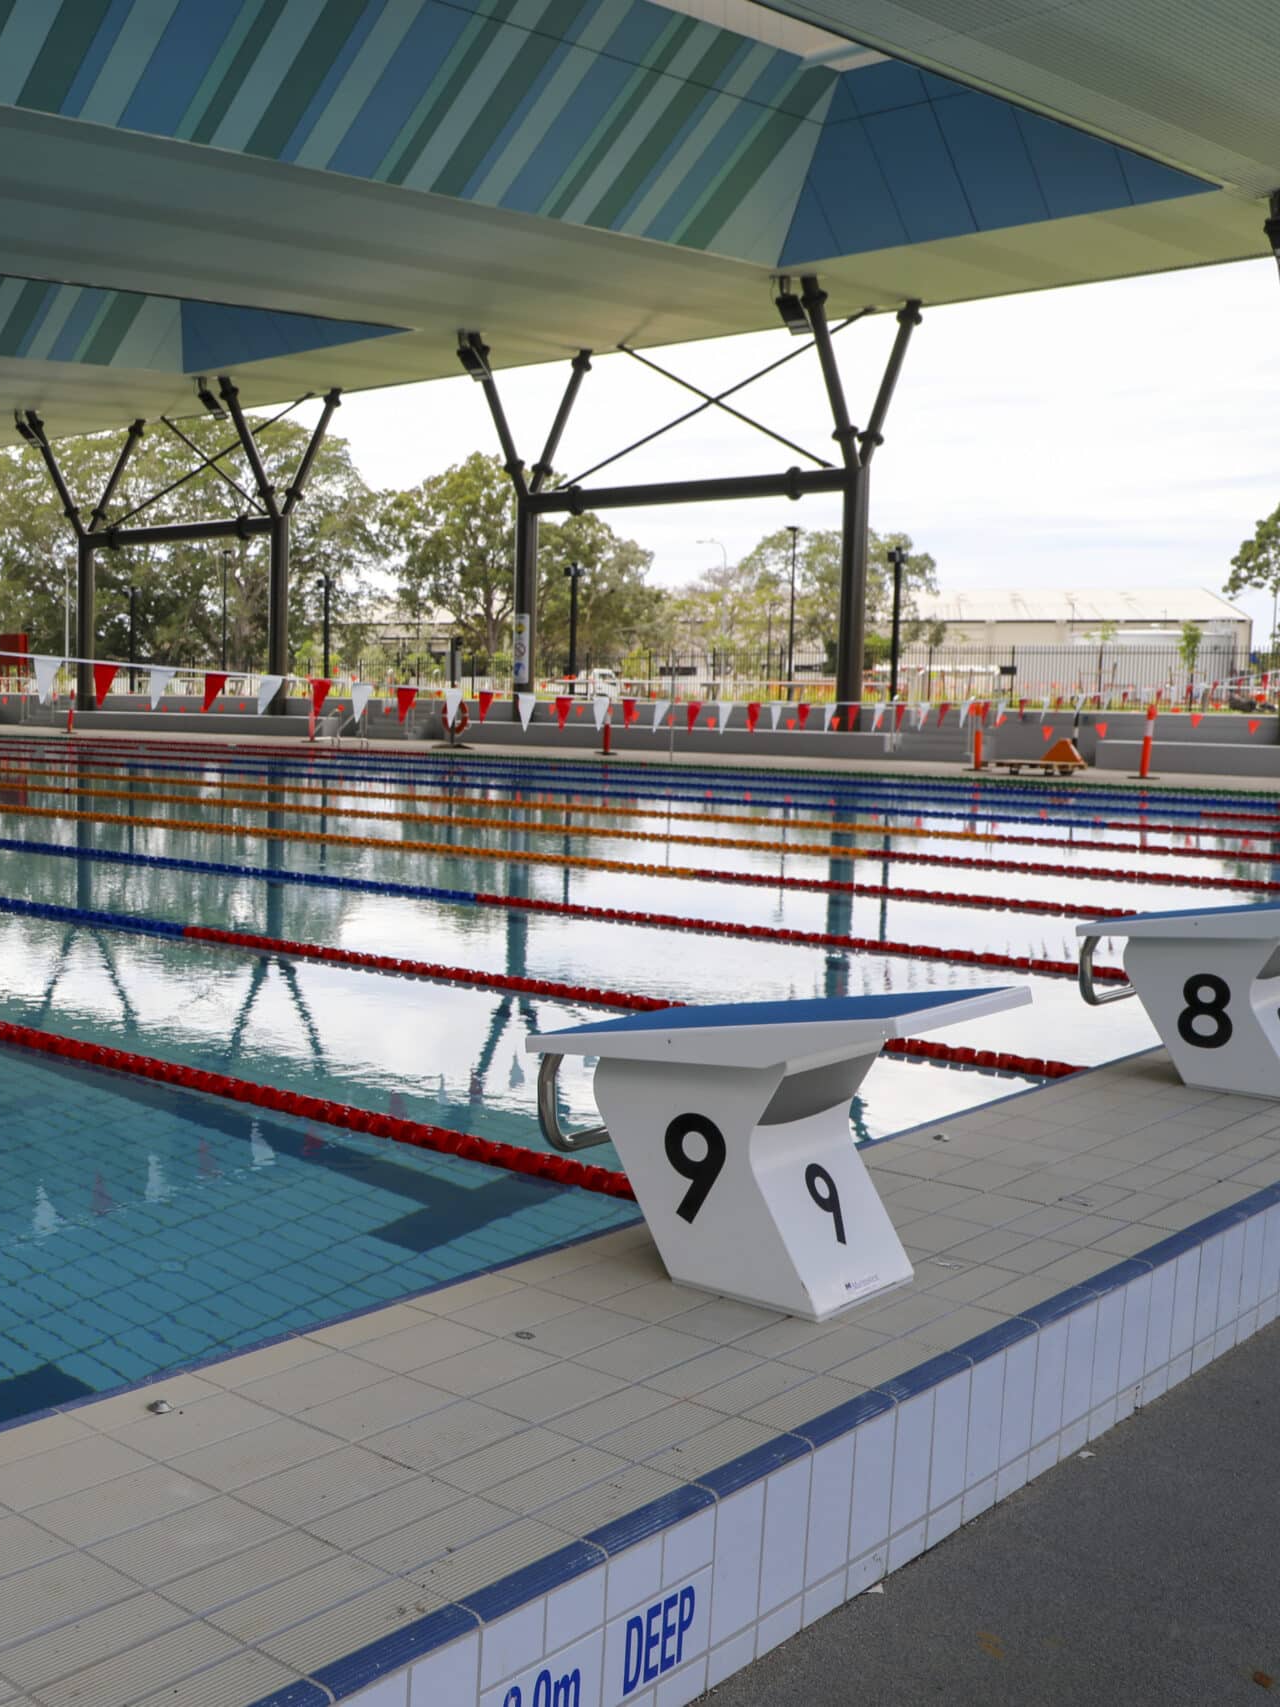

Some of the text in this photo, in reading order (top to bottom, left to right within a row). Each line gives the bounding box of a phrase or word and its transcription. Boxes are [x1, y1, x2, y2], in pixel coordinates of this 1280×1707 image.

[1177, 973, 1233, 1049] 8
[664, 1112, 727, 1225] 9
[805, 1163, 847, 1245] 9
[622, 1585, 695, 1696] DEEP
